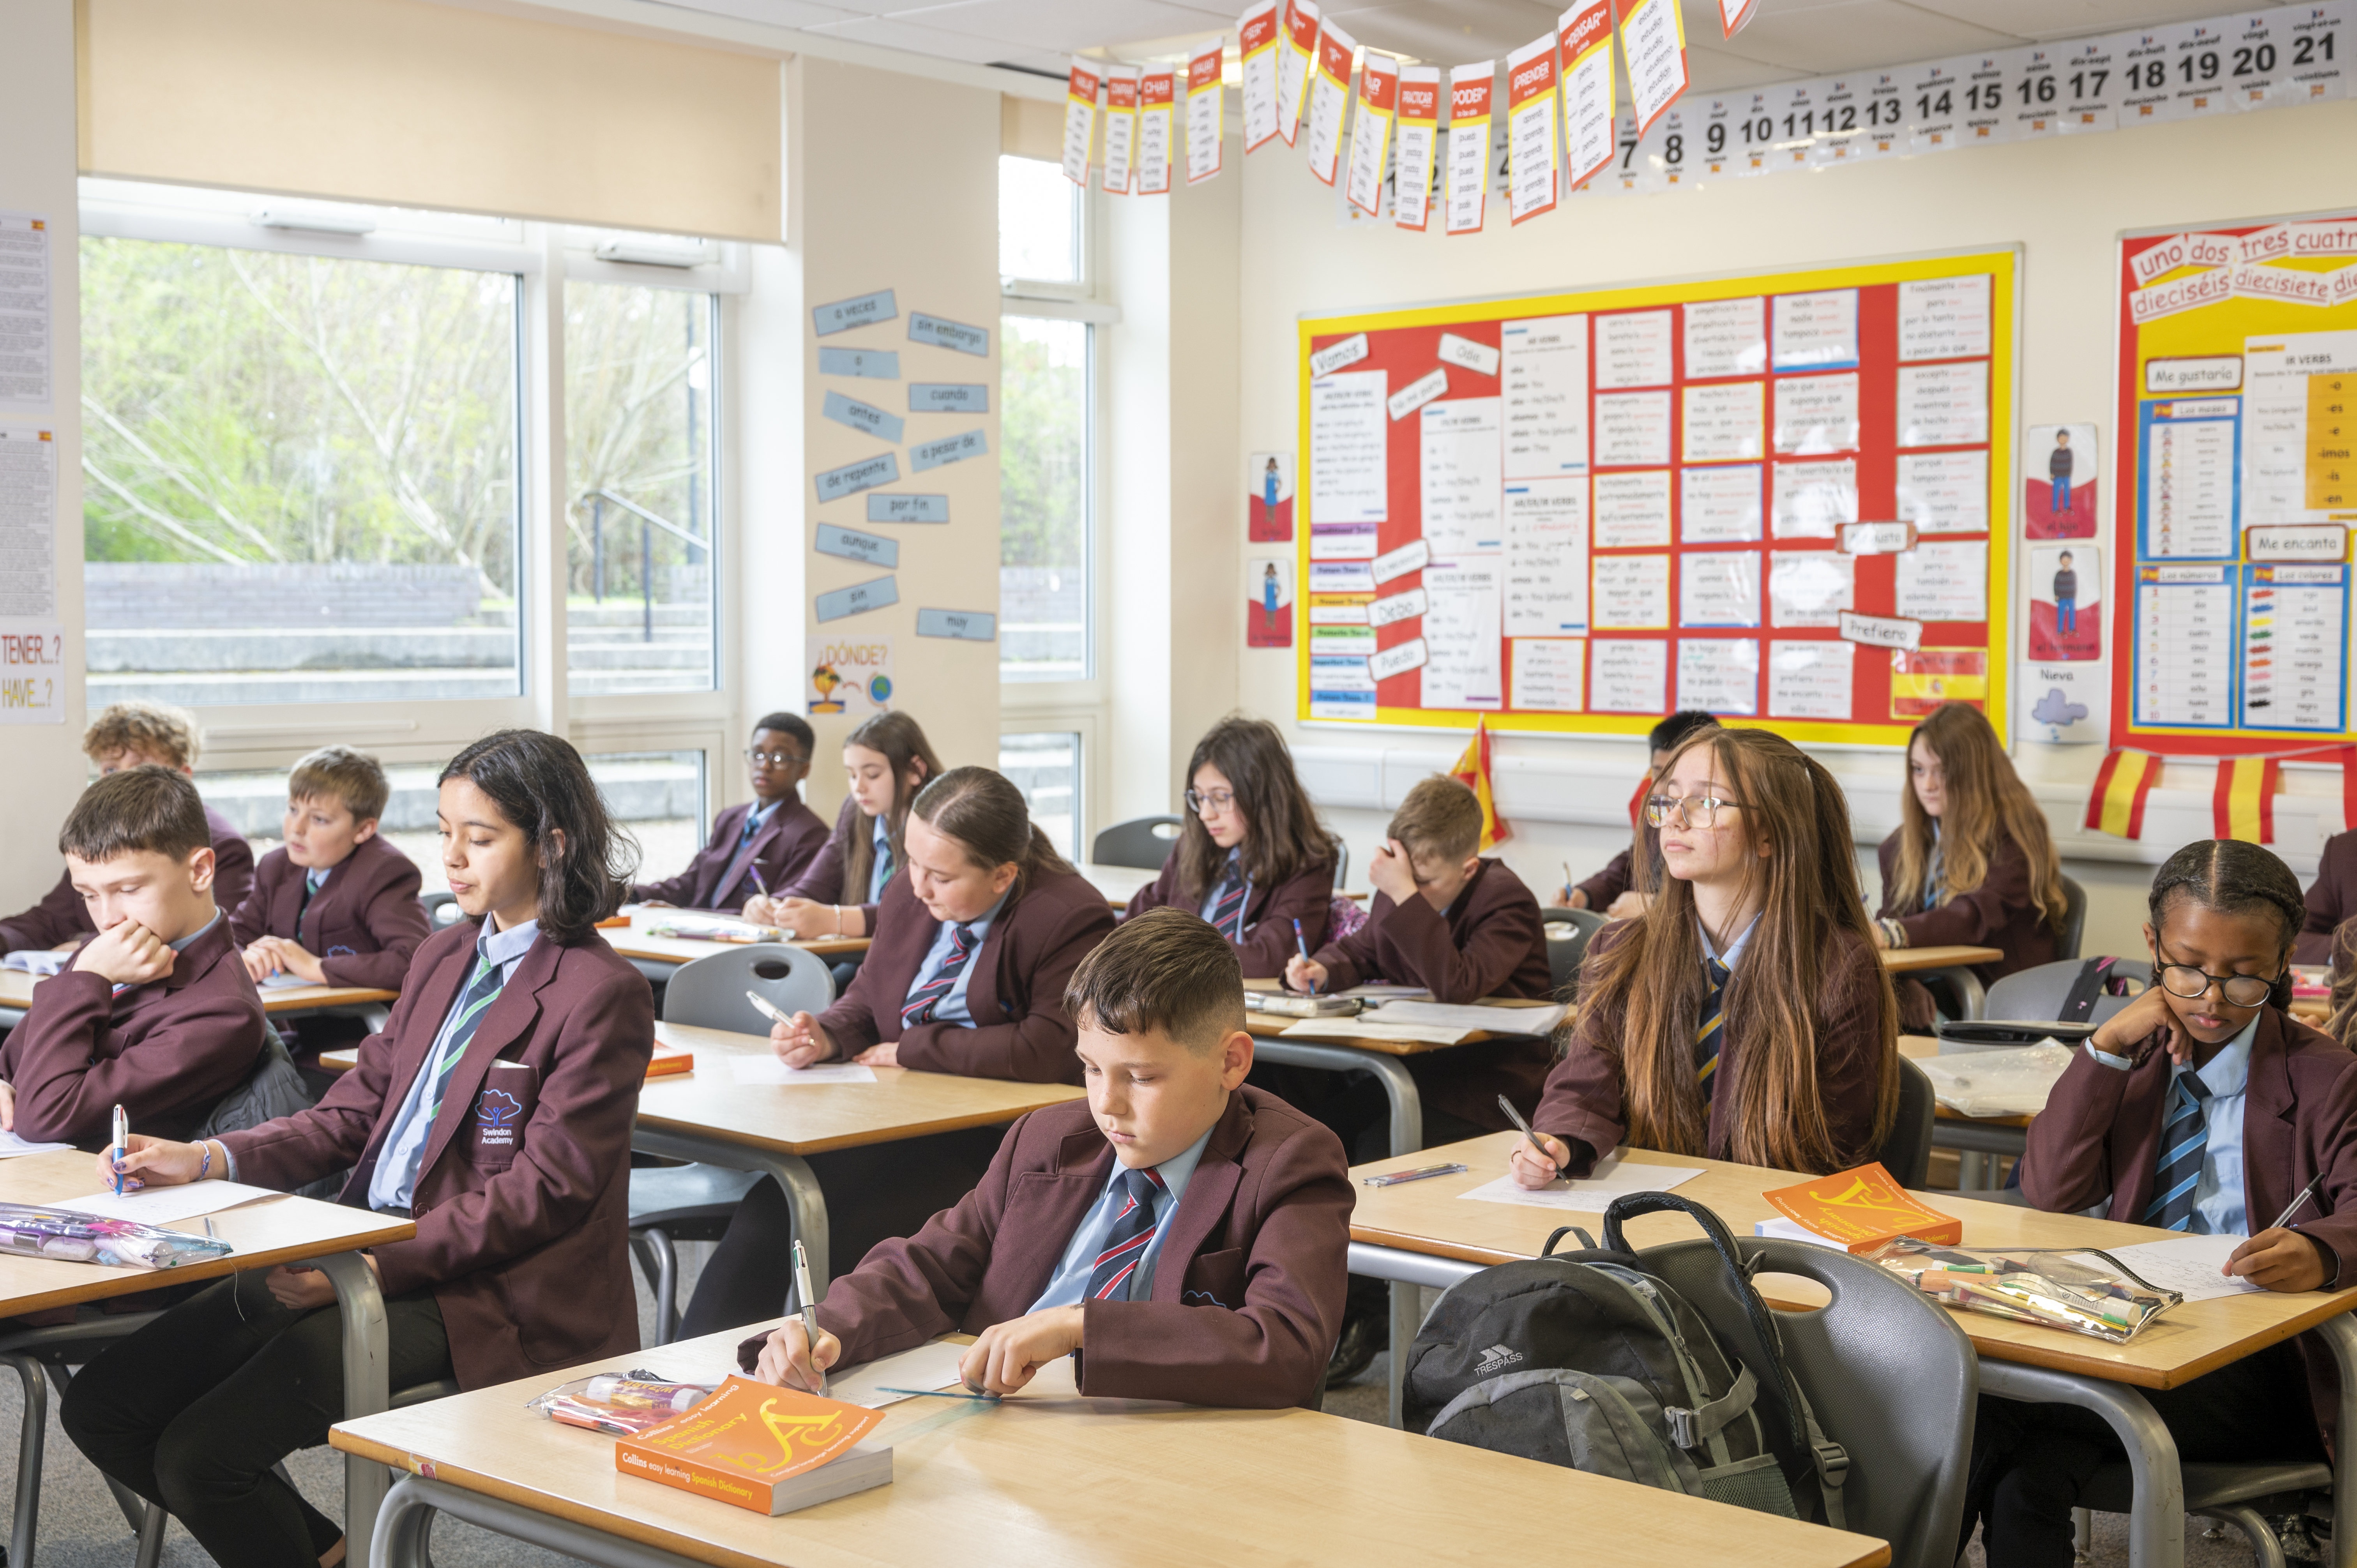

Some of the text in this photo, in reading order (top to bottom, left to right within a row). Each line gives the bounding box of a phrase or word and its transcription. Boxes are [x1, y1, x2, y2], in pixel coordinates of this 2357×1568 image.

[2231, 43, 2277, 77] 20
[2292, 31, 2334, 66] 21
[2125, 60, 2166, 91] 18
[2178, 51, 2220, 83] 19
[1965, 83, 2003, 111] 15
[2018, 75, 2057, 105] 16
[2069, 69, 2110, 99] 17
[1866, 98, 1901, 126] 13
[1916, 89, 1953, 119] 14
[1740, 116, 1772, 143] 10
[1783, 110, 1814, 137] 11
[1821, 105, 1857, 132] 12
[1665, 134, 1683, 164] 8
[1707, 122, 1726, 153] 9
[1619, 139, 1638, 168] 7
[2139, 244, 2182, 275] uno
[2191, 238, 2230, 263] dos
[2239, 229, 2288, 258] tres
[2134, 272, 2230, 314] dieciséis
[2235, 268, 2329, 297] diecisiete
[936, 322, 982, 346] embargo
[2299, 353, 2332, 365] VERBS
[2155, 365, 2232, 386] Me gustaría
[929, 387, 968, 401] cuando
[848, 404, 880, 425] antes
[2259, 537, 2337, 550] Me encanta
[947, 615, 968, 630] muy
[1378, 601, 1414, 623] Debo
[1850, 620, 1907, 641] Prefiero
[2041, 669, 2074, 682] Nieva
[482, 1137, 513, 1145] Academy
[1775, 1196, 1850, 1242] Collins easy learning
[1818, 1207, 1878, 1236] Dictionary
[1819, 1218, 1865, 1239] Spanish
[1925, 1234, 1949, 1243] Dictionary
[1474, 1352, 1523, 1376] TRESPASS
[637, 1384, 739, 1439] Collins easy learning
[652, 1420, 715, 1445] Spanish
[667, 1413, 747, 1450] Dictionary
[770, 1416, 869, 1478] Complete language learning support
[622, 1452, 753, 1501] Collins easy learning Spanish Dictionary
